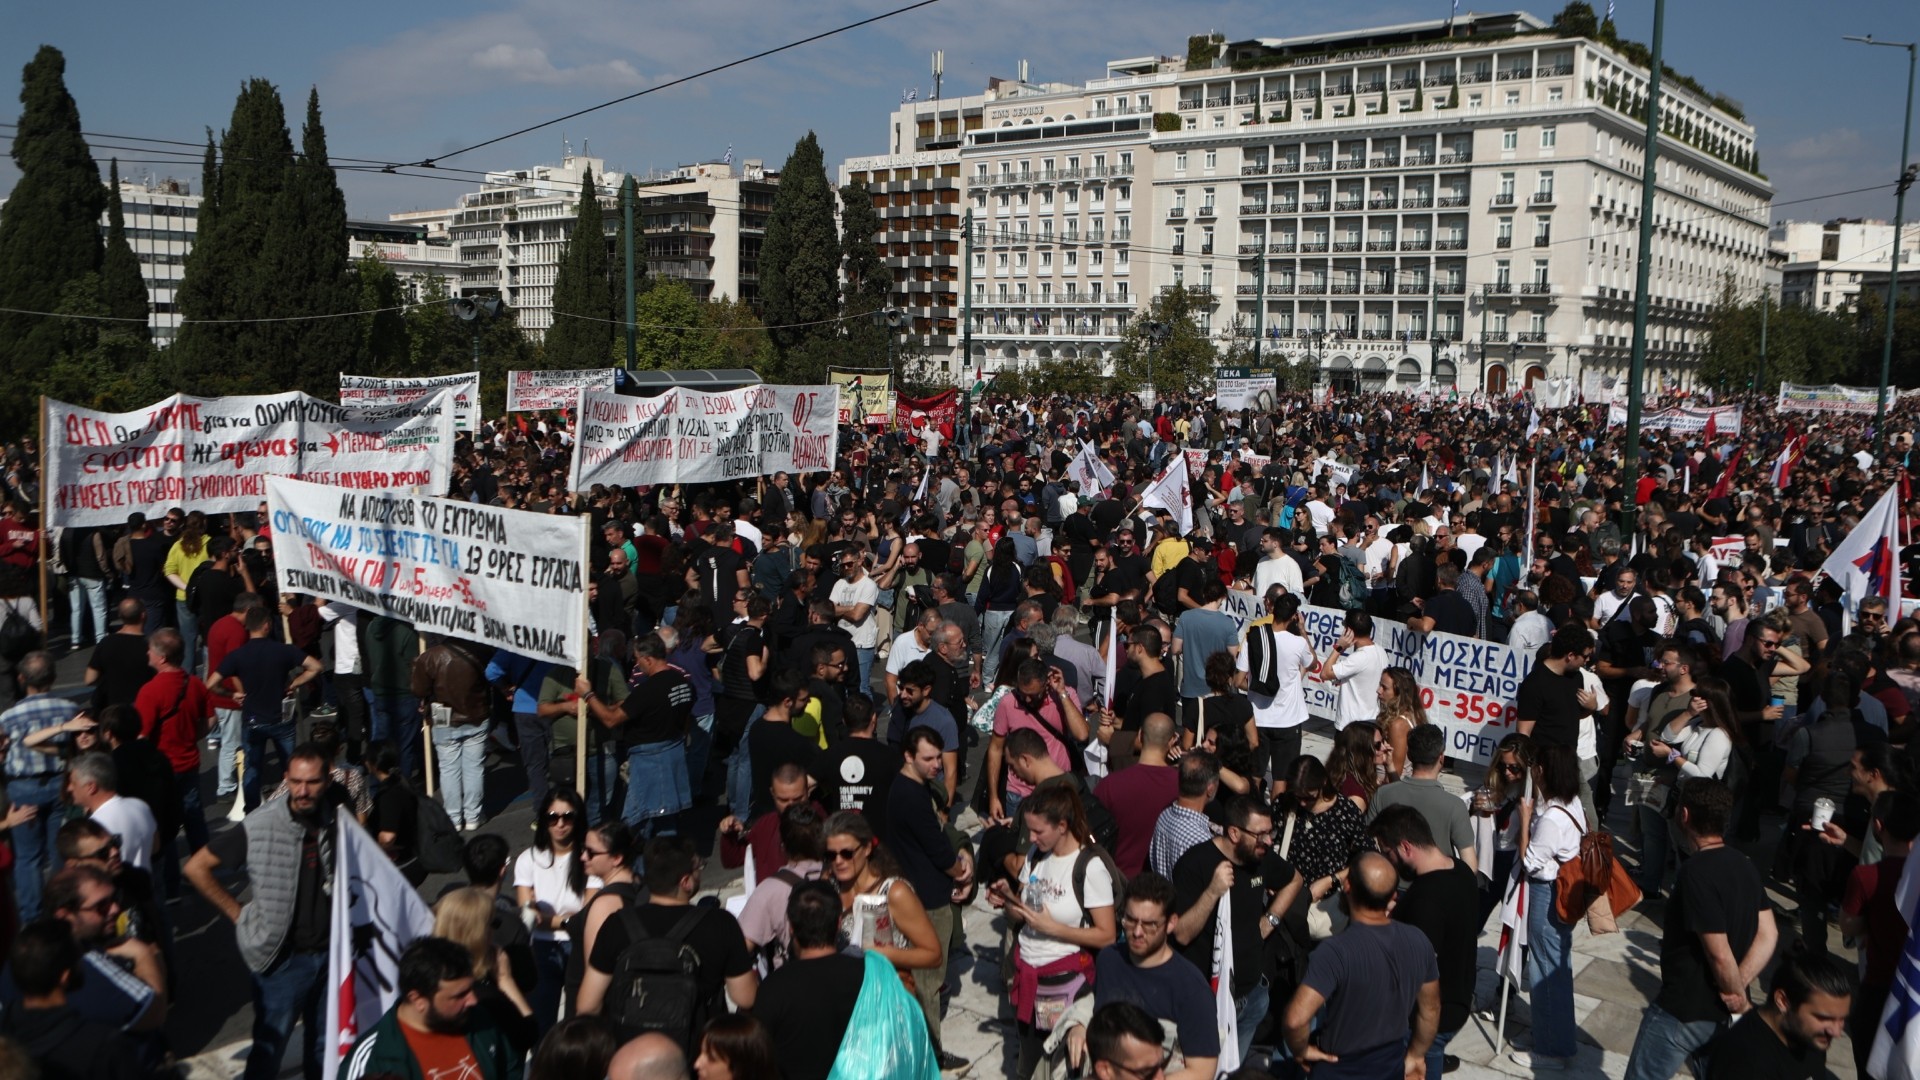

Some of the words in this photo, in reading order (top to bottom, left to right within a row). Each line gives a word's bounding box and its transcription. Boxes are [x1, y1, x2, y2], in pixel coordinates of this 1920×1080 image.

[1294, 54, 1329, 66] HOTEL
[991, 109, 1010, 120] KING
[1012, 105, 1045, 118] GEORGE
[873, 152, 917, 169] ATHENS
[919, 150, 959, 164] PLAZA
[1279, 342, 1309, 350] HOTEL
[1356, 344, 1409, 352] BRETAGNE
[356, 377, 388, 389] ΖΟΥΜΕ
[391, 380, 406, 389] ΓΙΑ
[408, 380, 421, 388] ΝΑ
[114, 425, 141, 443] θα
[144, 403, 204, 435] ΖΟΥΜΕ
[203, 414, 228, 434] για
[230, 414, 251, 429] να
[679, 437, 697, 459] ΟΧΙ
[391, 470, 431, 487] ΧΡΟΝΟ
[339, 493, 356, 520] ΝΑ
[421, 500, 438, 529] ΤΟ
[442, 504, 507, 545] ΕΚΤΡΩΜΑ
[330, 524, 353, 550] ΝΑ
[464, 545, 483, 575] 13
[486, 548, 526, 583] ΩΡΕΣ
[531, 555, 583, 594] ΕΡΓΑΣΙΑ
[361, 559, 387, 589] ΓΙΑ
[513, 624, 568, 660] ΕΛΛΑΔΑΣ
[1225, 596, 1249, 616] ΝΑ
[1391, 626, 1535, 679] ΝΟΜΟΣΧΕΔΙ
[1434, 665, 1520, 700] ΜΕΣΑΙΩ
